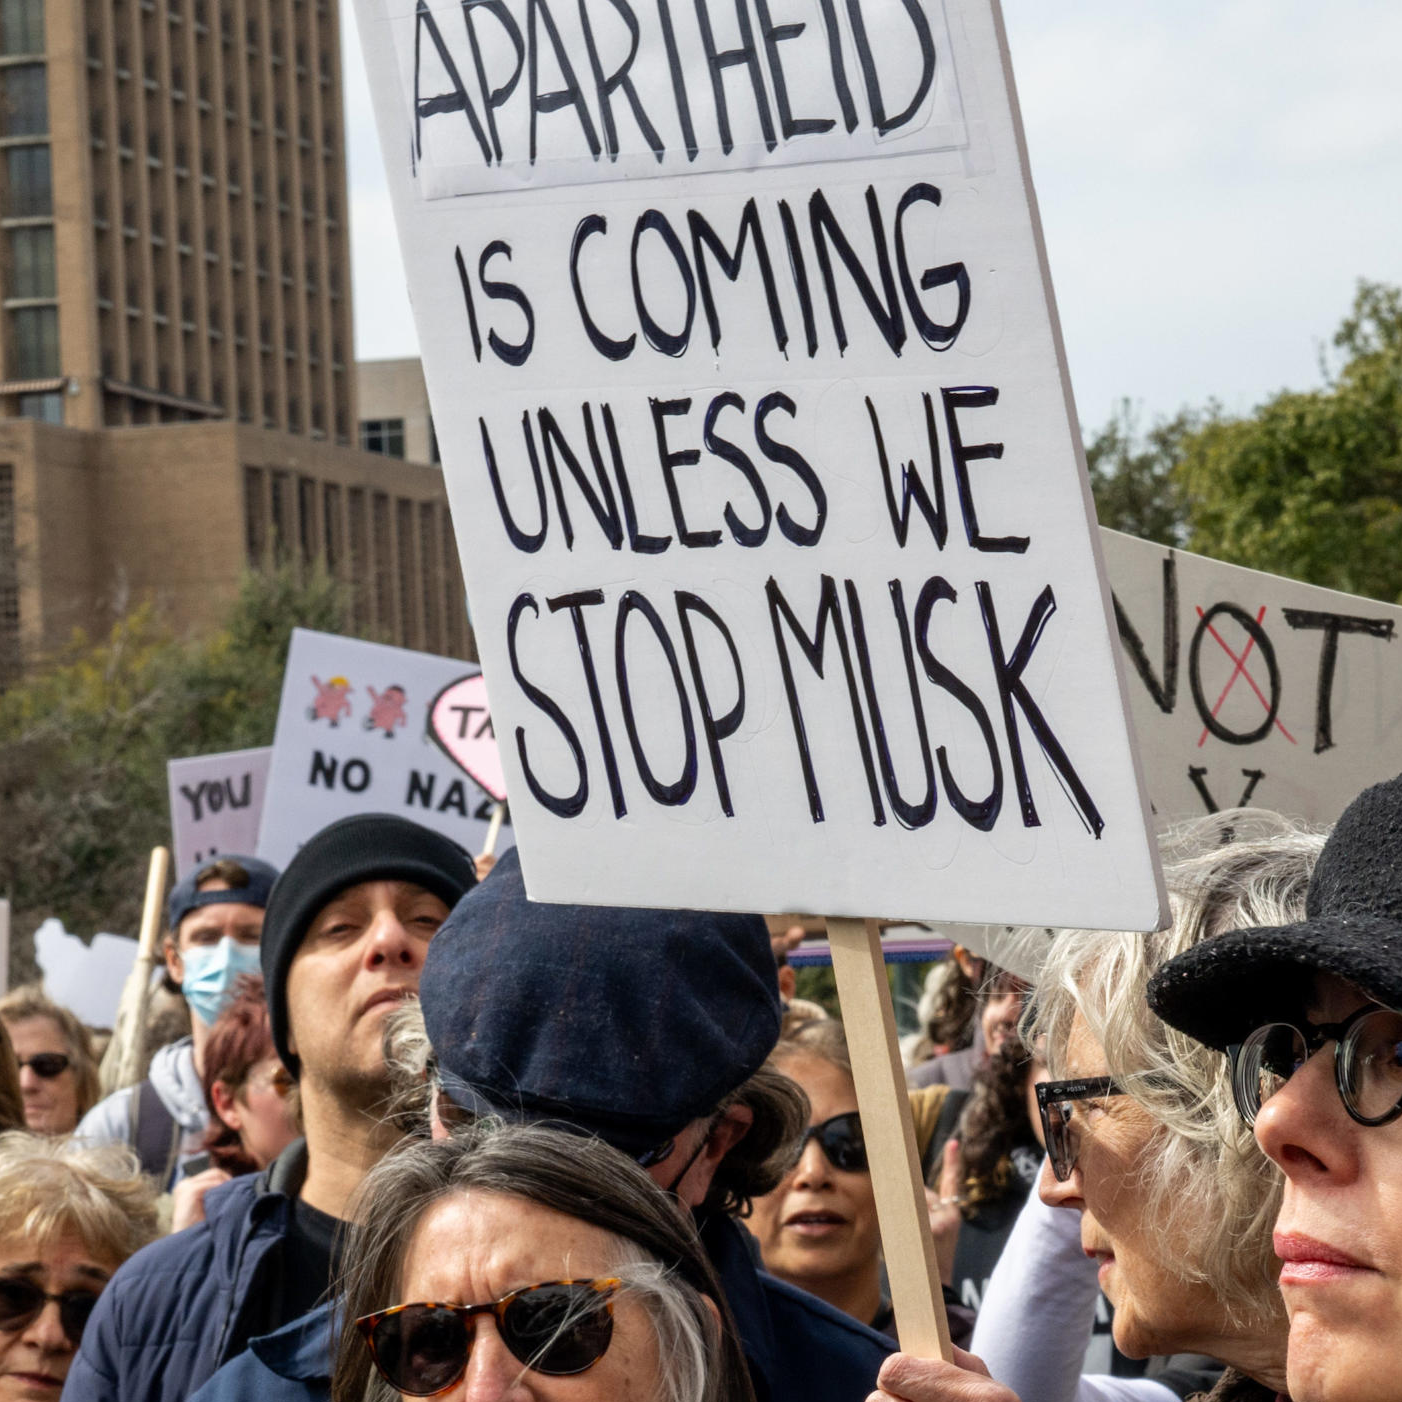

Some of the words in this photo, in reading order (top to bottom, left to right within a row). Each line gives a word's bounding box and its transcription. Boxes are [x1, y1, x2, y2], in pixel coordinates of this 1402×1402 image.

[412, 0, 938, 176] APARTHEID
[453, 239, 536, 366] IS
[569, 181, 971, 362] COMING
[478, 390, 829, 554] UNLESS
[864, 385, 1032, 553] WE
[506, 586, 746, 821] STOP
[765, 573, 1106, 840] MUSK
[1111, 552, 1398, 754] NOT
[180, 772, 253, 822] YOU
[308, 750, 372, 793] NO
[405, 769, 512, 826] NAZ
